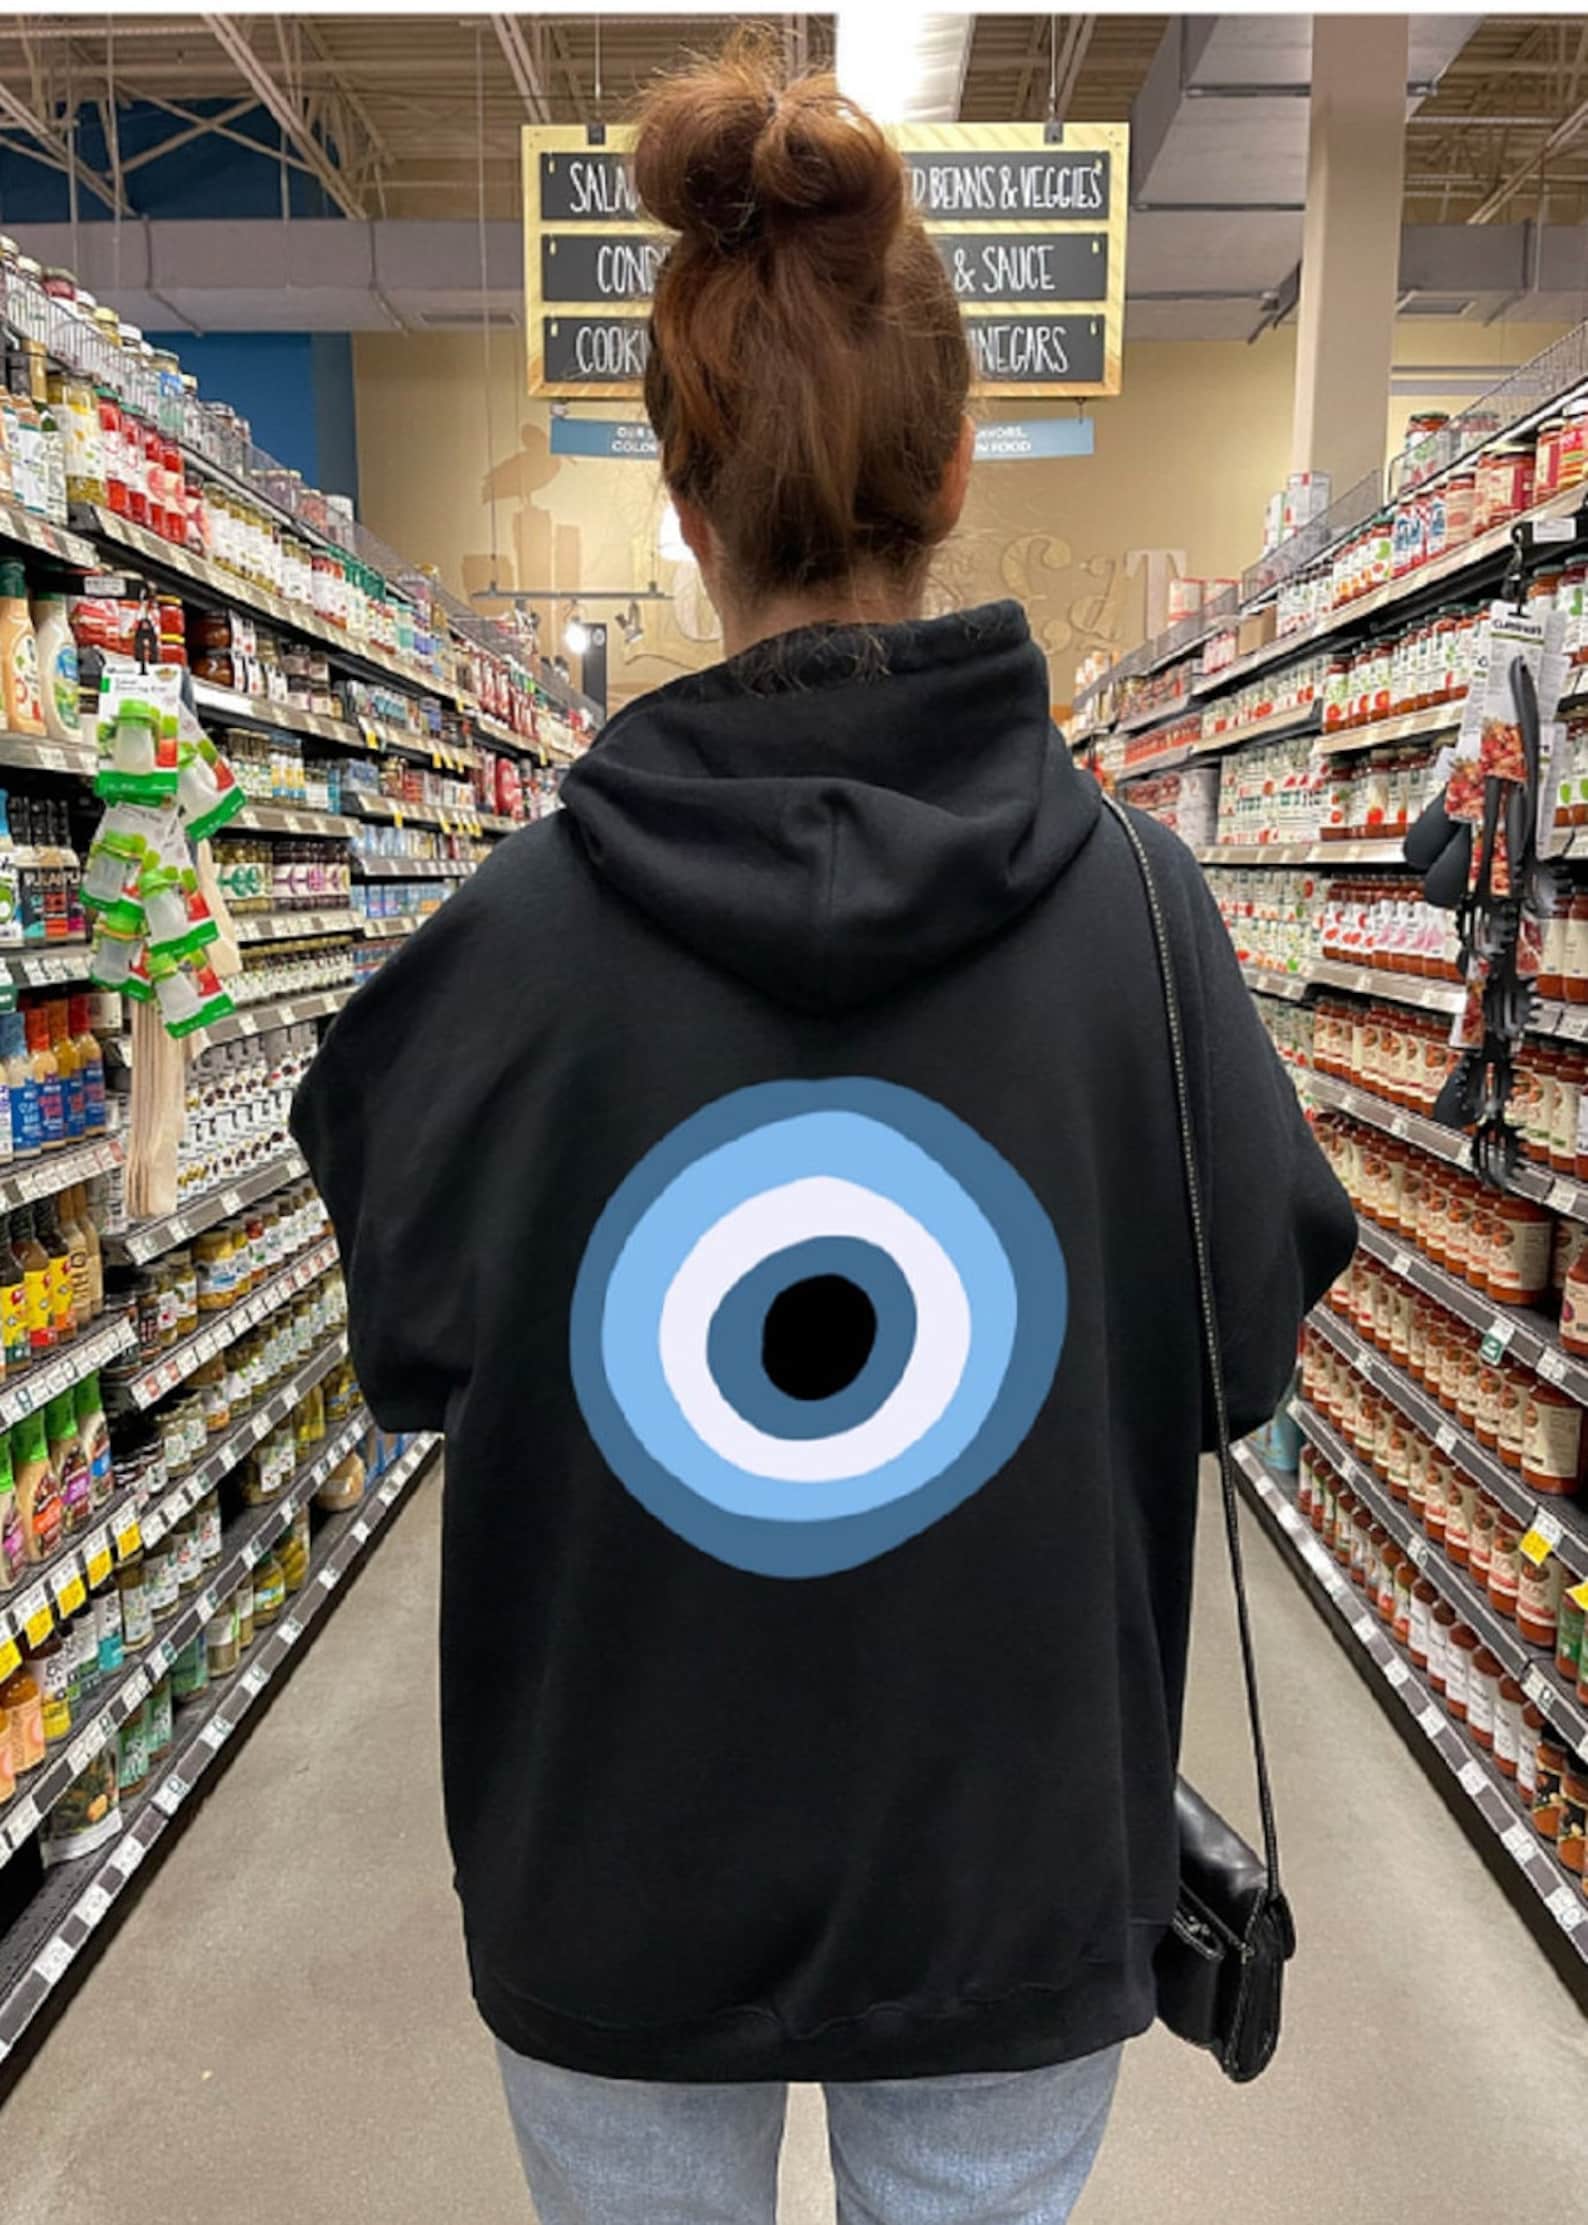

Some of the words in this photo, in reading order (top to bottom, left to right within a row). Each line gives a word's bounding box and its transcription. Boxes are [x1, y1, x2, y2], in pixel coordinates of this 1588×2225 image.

[929, 165, 996, 210] BEANS
[1000, 164, 1018, 210] &
[1020, 164, 1102, 209] VEGGIES
[597, 244, 668, 294] COND
[953, 247, 977, 292] &
[981, 244, 1056, 293] SAUCE
[990, 439, 1032, 453] FOOD
